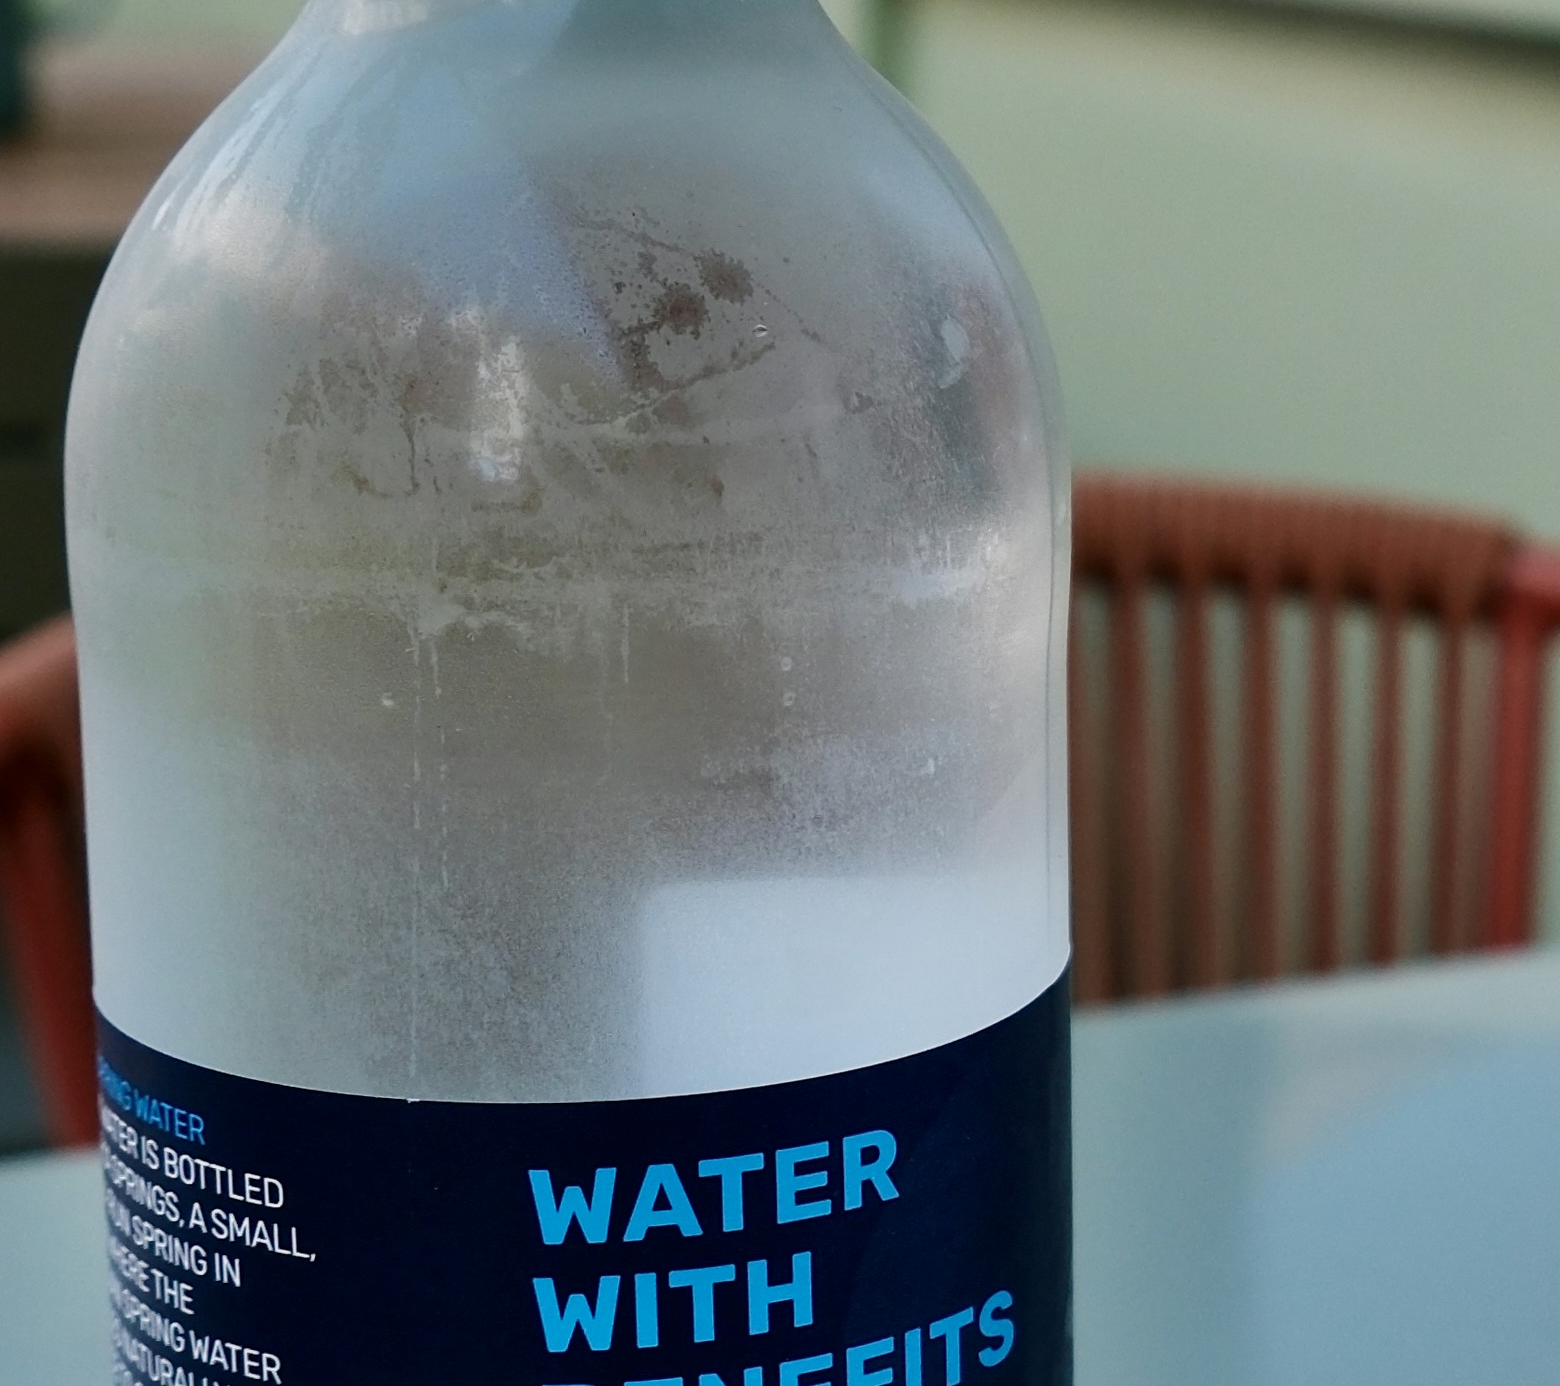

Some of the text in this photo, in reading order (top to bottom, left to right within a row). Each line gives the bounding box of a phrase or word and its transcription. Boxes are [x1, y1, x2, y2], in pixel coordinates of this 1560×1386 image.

[134, 1087, 206, 1145] WATER
[141, 1135, 159, 1170] IS
[163, 1146, 284, 1209] BOTTLED
[528, 1128, 900, 1245] WATER
[131, 1215, 242, 1288] SPRING IN
[189, 1202, 208, 1234] A
[210, 1208, 317, 1263] SMALL,
[150, 1267, 195, 1315] THE
[532, 1250, 814, 1353] WITH
[189, 1329, 282, 1386] WATER
